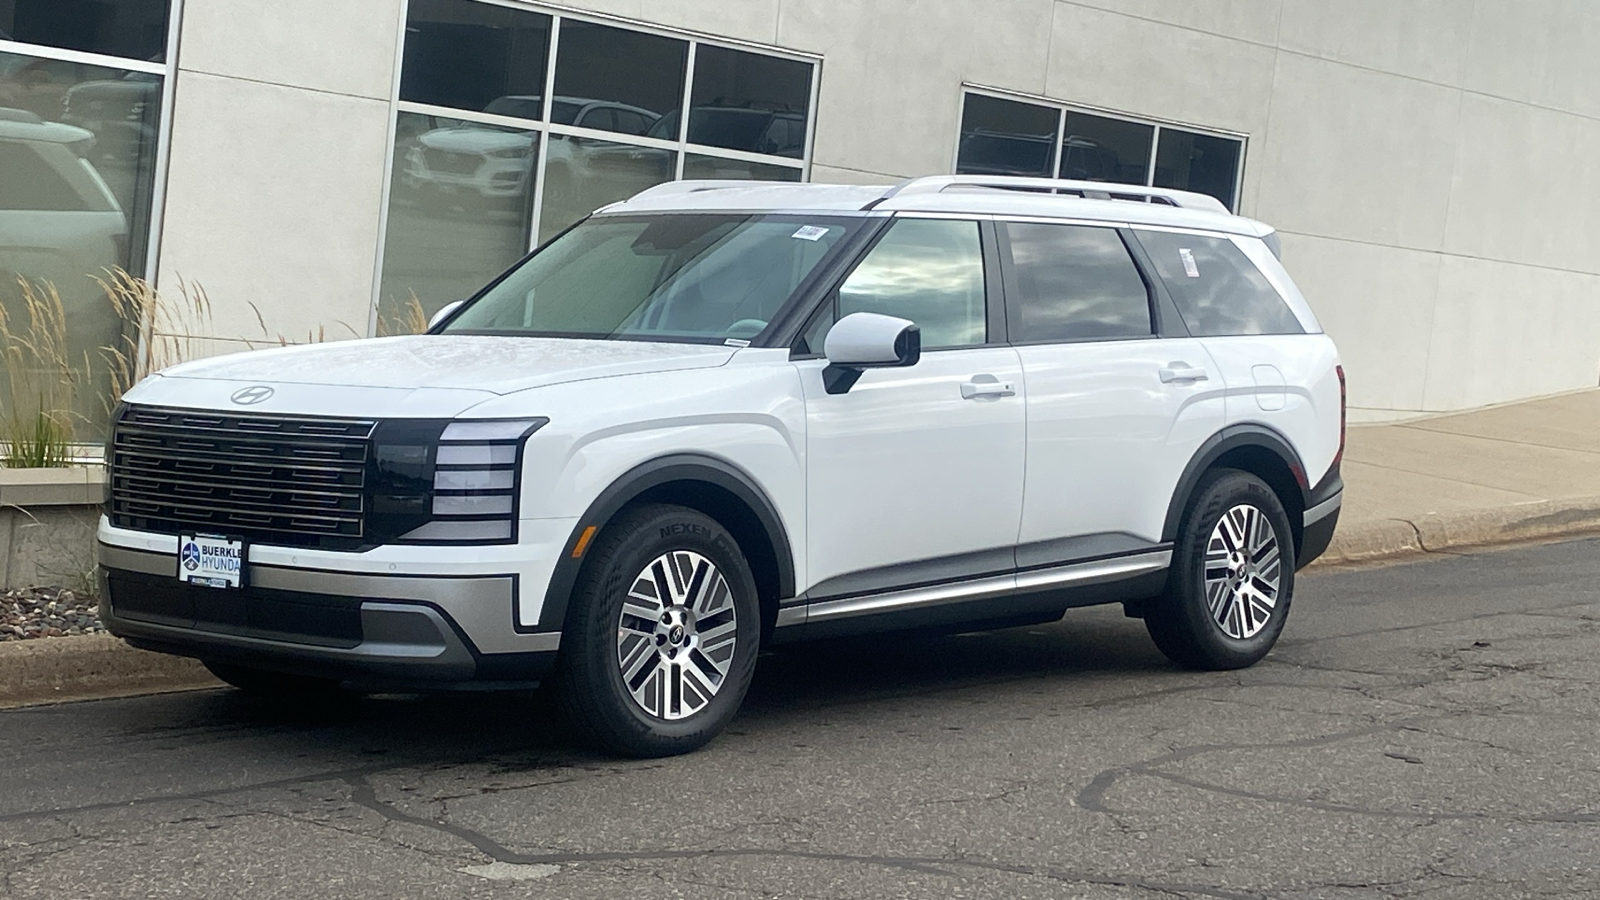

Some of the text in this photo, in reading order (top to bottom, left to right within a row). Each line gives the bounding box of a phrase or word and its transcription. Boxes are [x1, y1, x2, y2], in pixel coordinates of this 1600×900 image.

[660, 523, 711, 539] NEXEN
[202, 545, 242, 559] BUERKLE
[202, 556, 241, 572] HYUNDA
